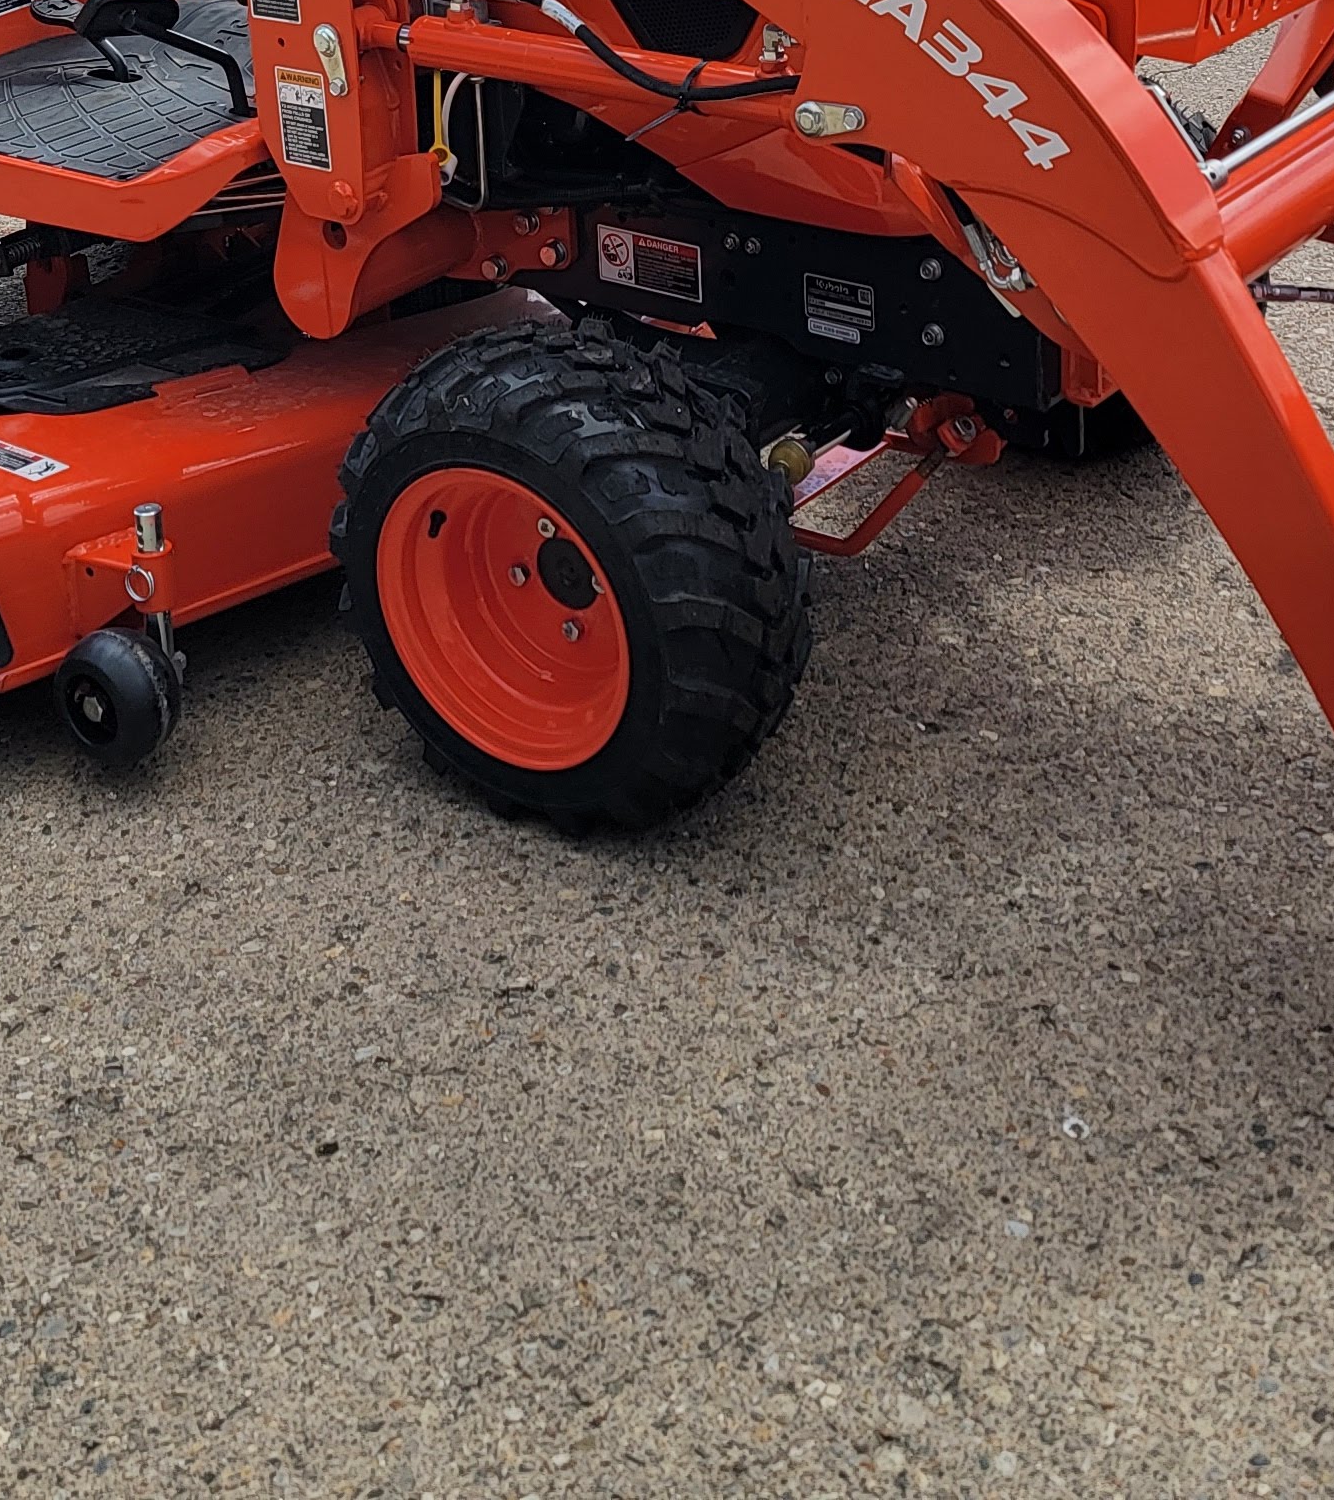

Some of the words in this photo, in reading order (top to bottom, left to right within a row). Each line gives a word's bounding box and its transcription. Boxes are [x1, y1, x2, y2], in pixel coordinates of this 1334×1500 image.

[286, 72, 320, 86] WARNING
[647, 239, 679, 254] DANGER
[816, 279, 849, 295] Kubota
